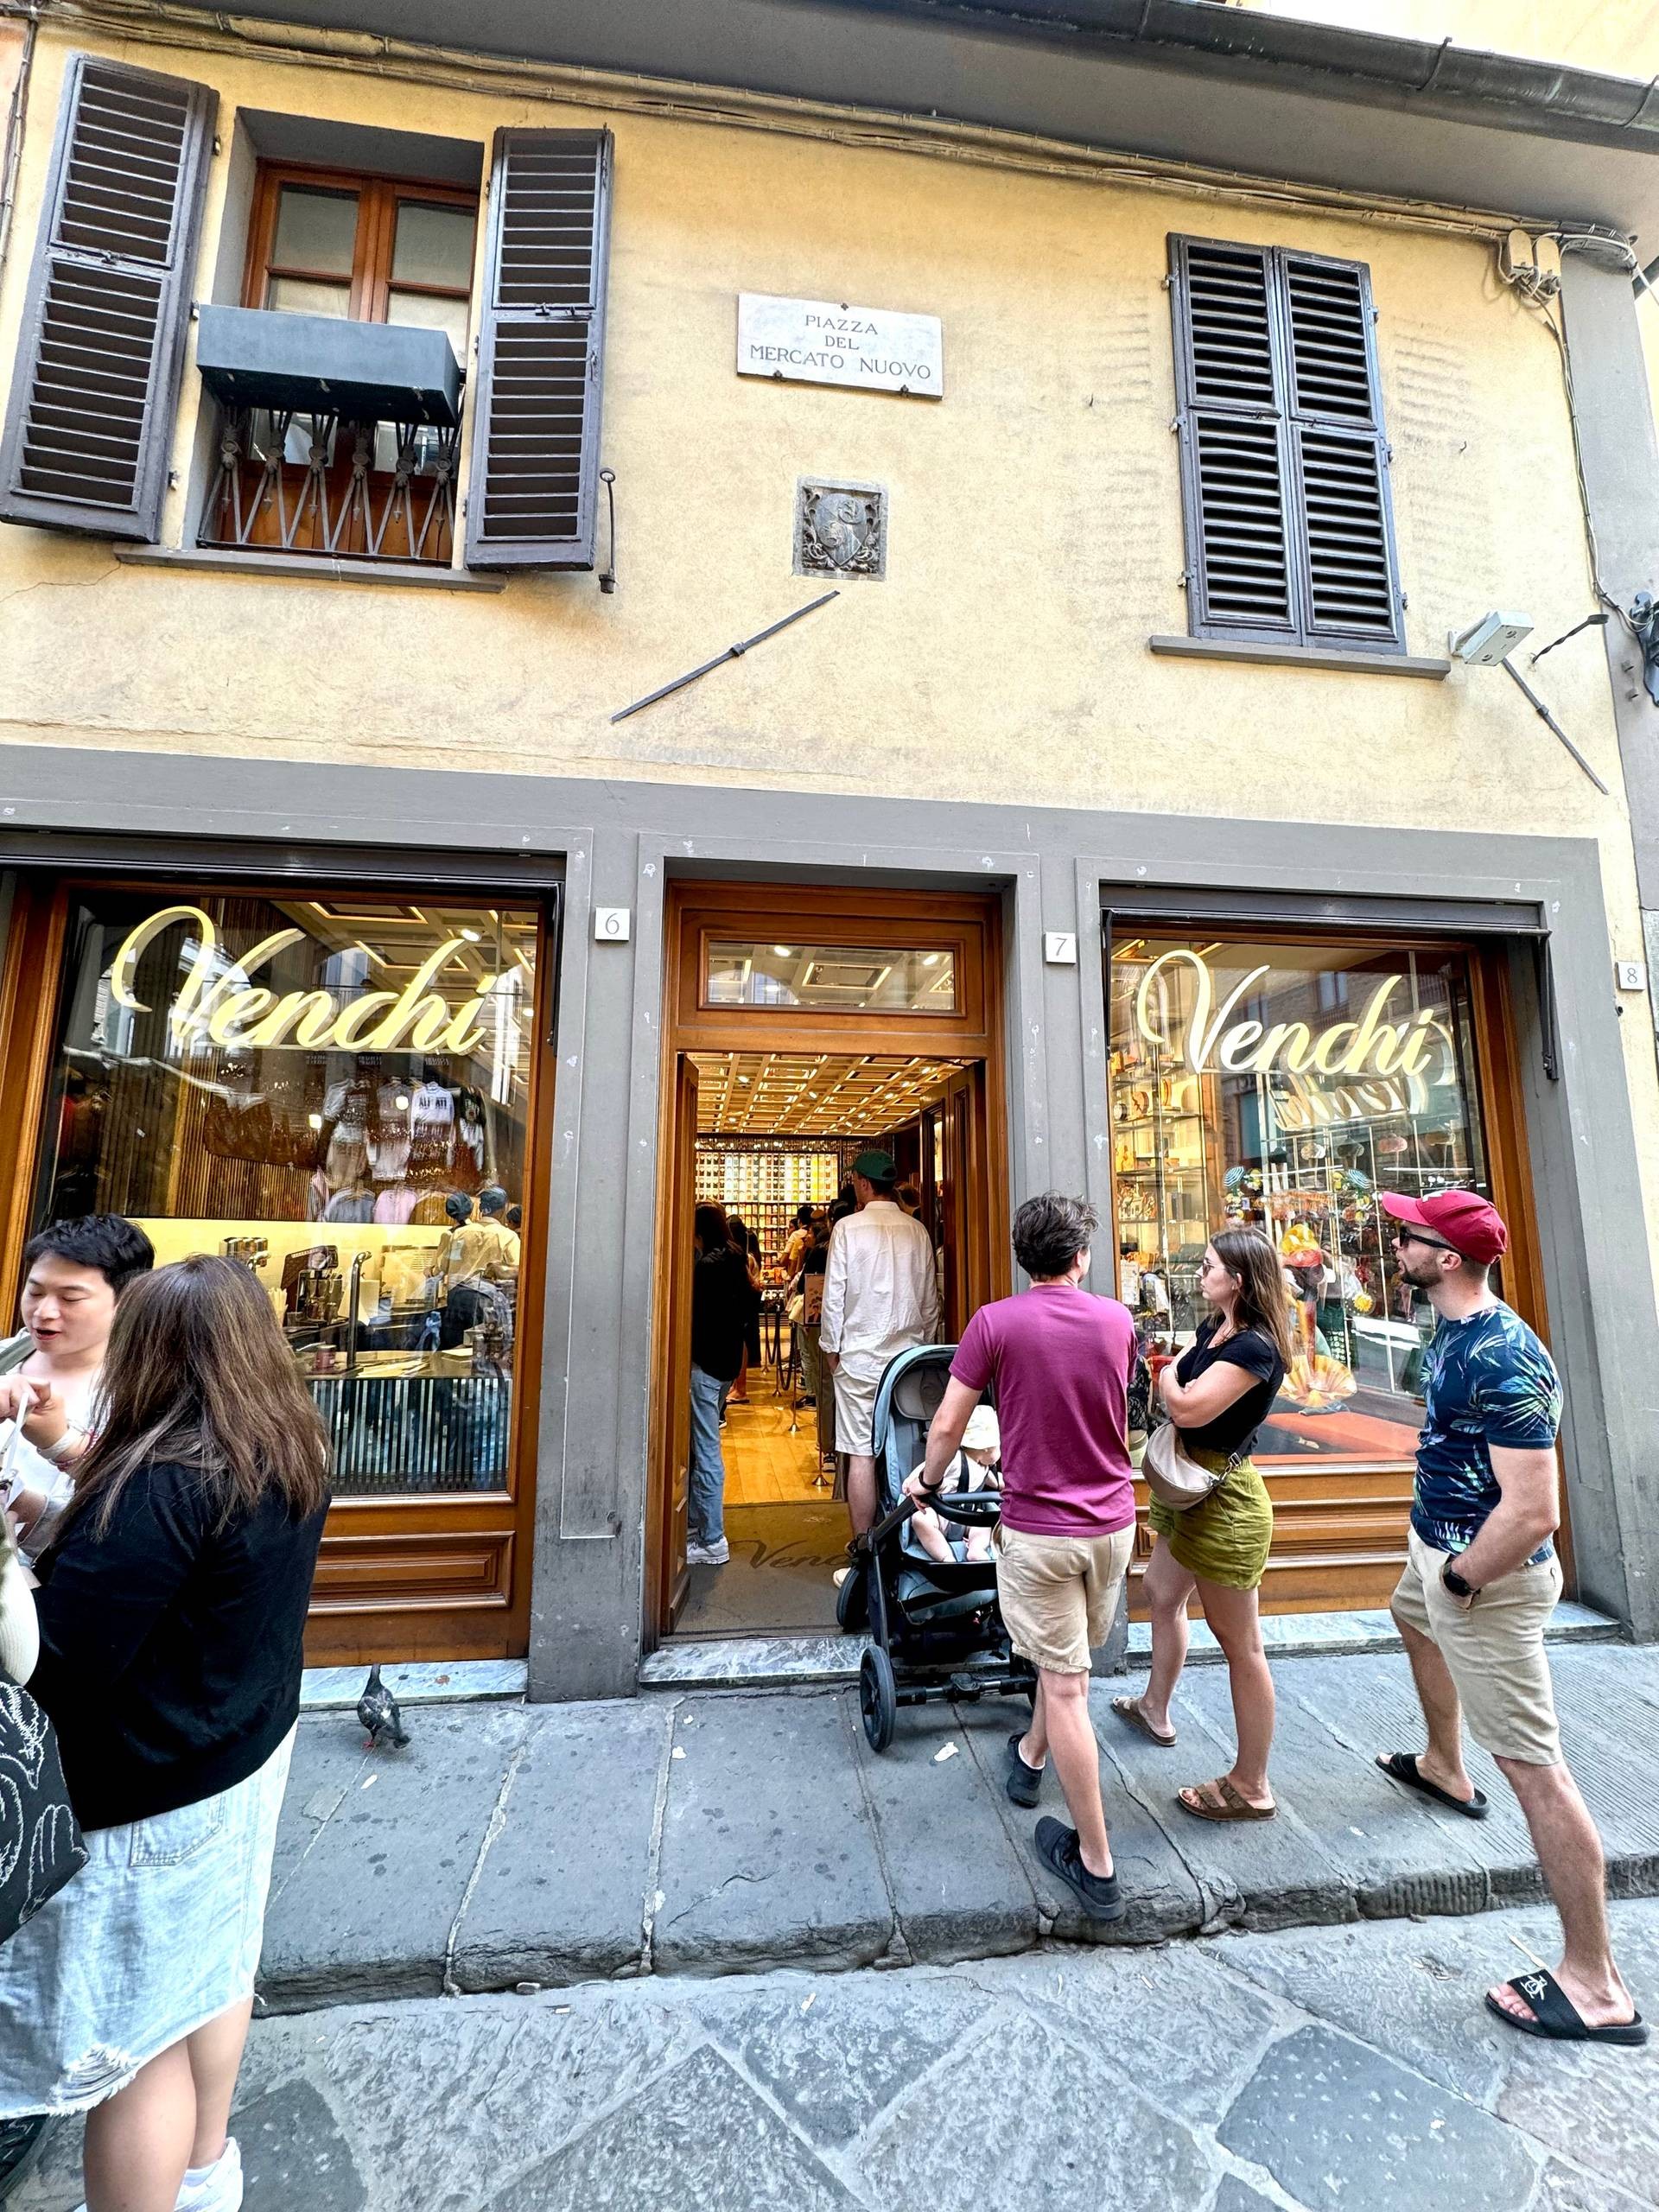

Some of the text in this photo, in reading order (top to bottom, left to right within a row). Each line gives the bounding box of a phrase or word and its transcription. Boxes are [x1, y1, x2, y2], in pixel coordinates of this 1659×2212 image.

[805, 315, 878, 335] PIAZZA
[825, 335, 860, 350] DEL
[750, 345, 931, 379] MERCATO NUOVO
[605, 912, 620, 935] 6
[1055, 938, 1068, 957] 7
[111, 905, 499, 1054] Venchi
[1627, 967, 1638, 984] 8
[1137, 950, 1434, 1077] Venchi
[728, 1539, 849, 1568] Venc
